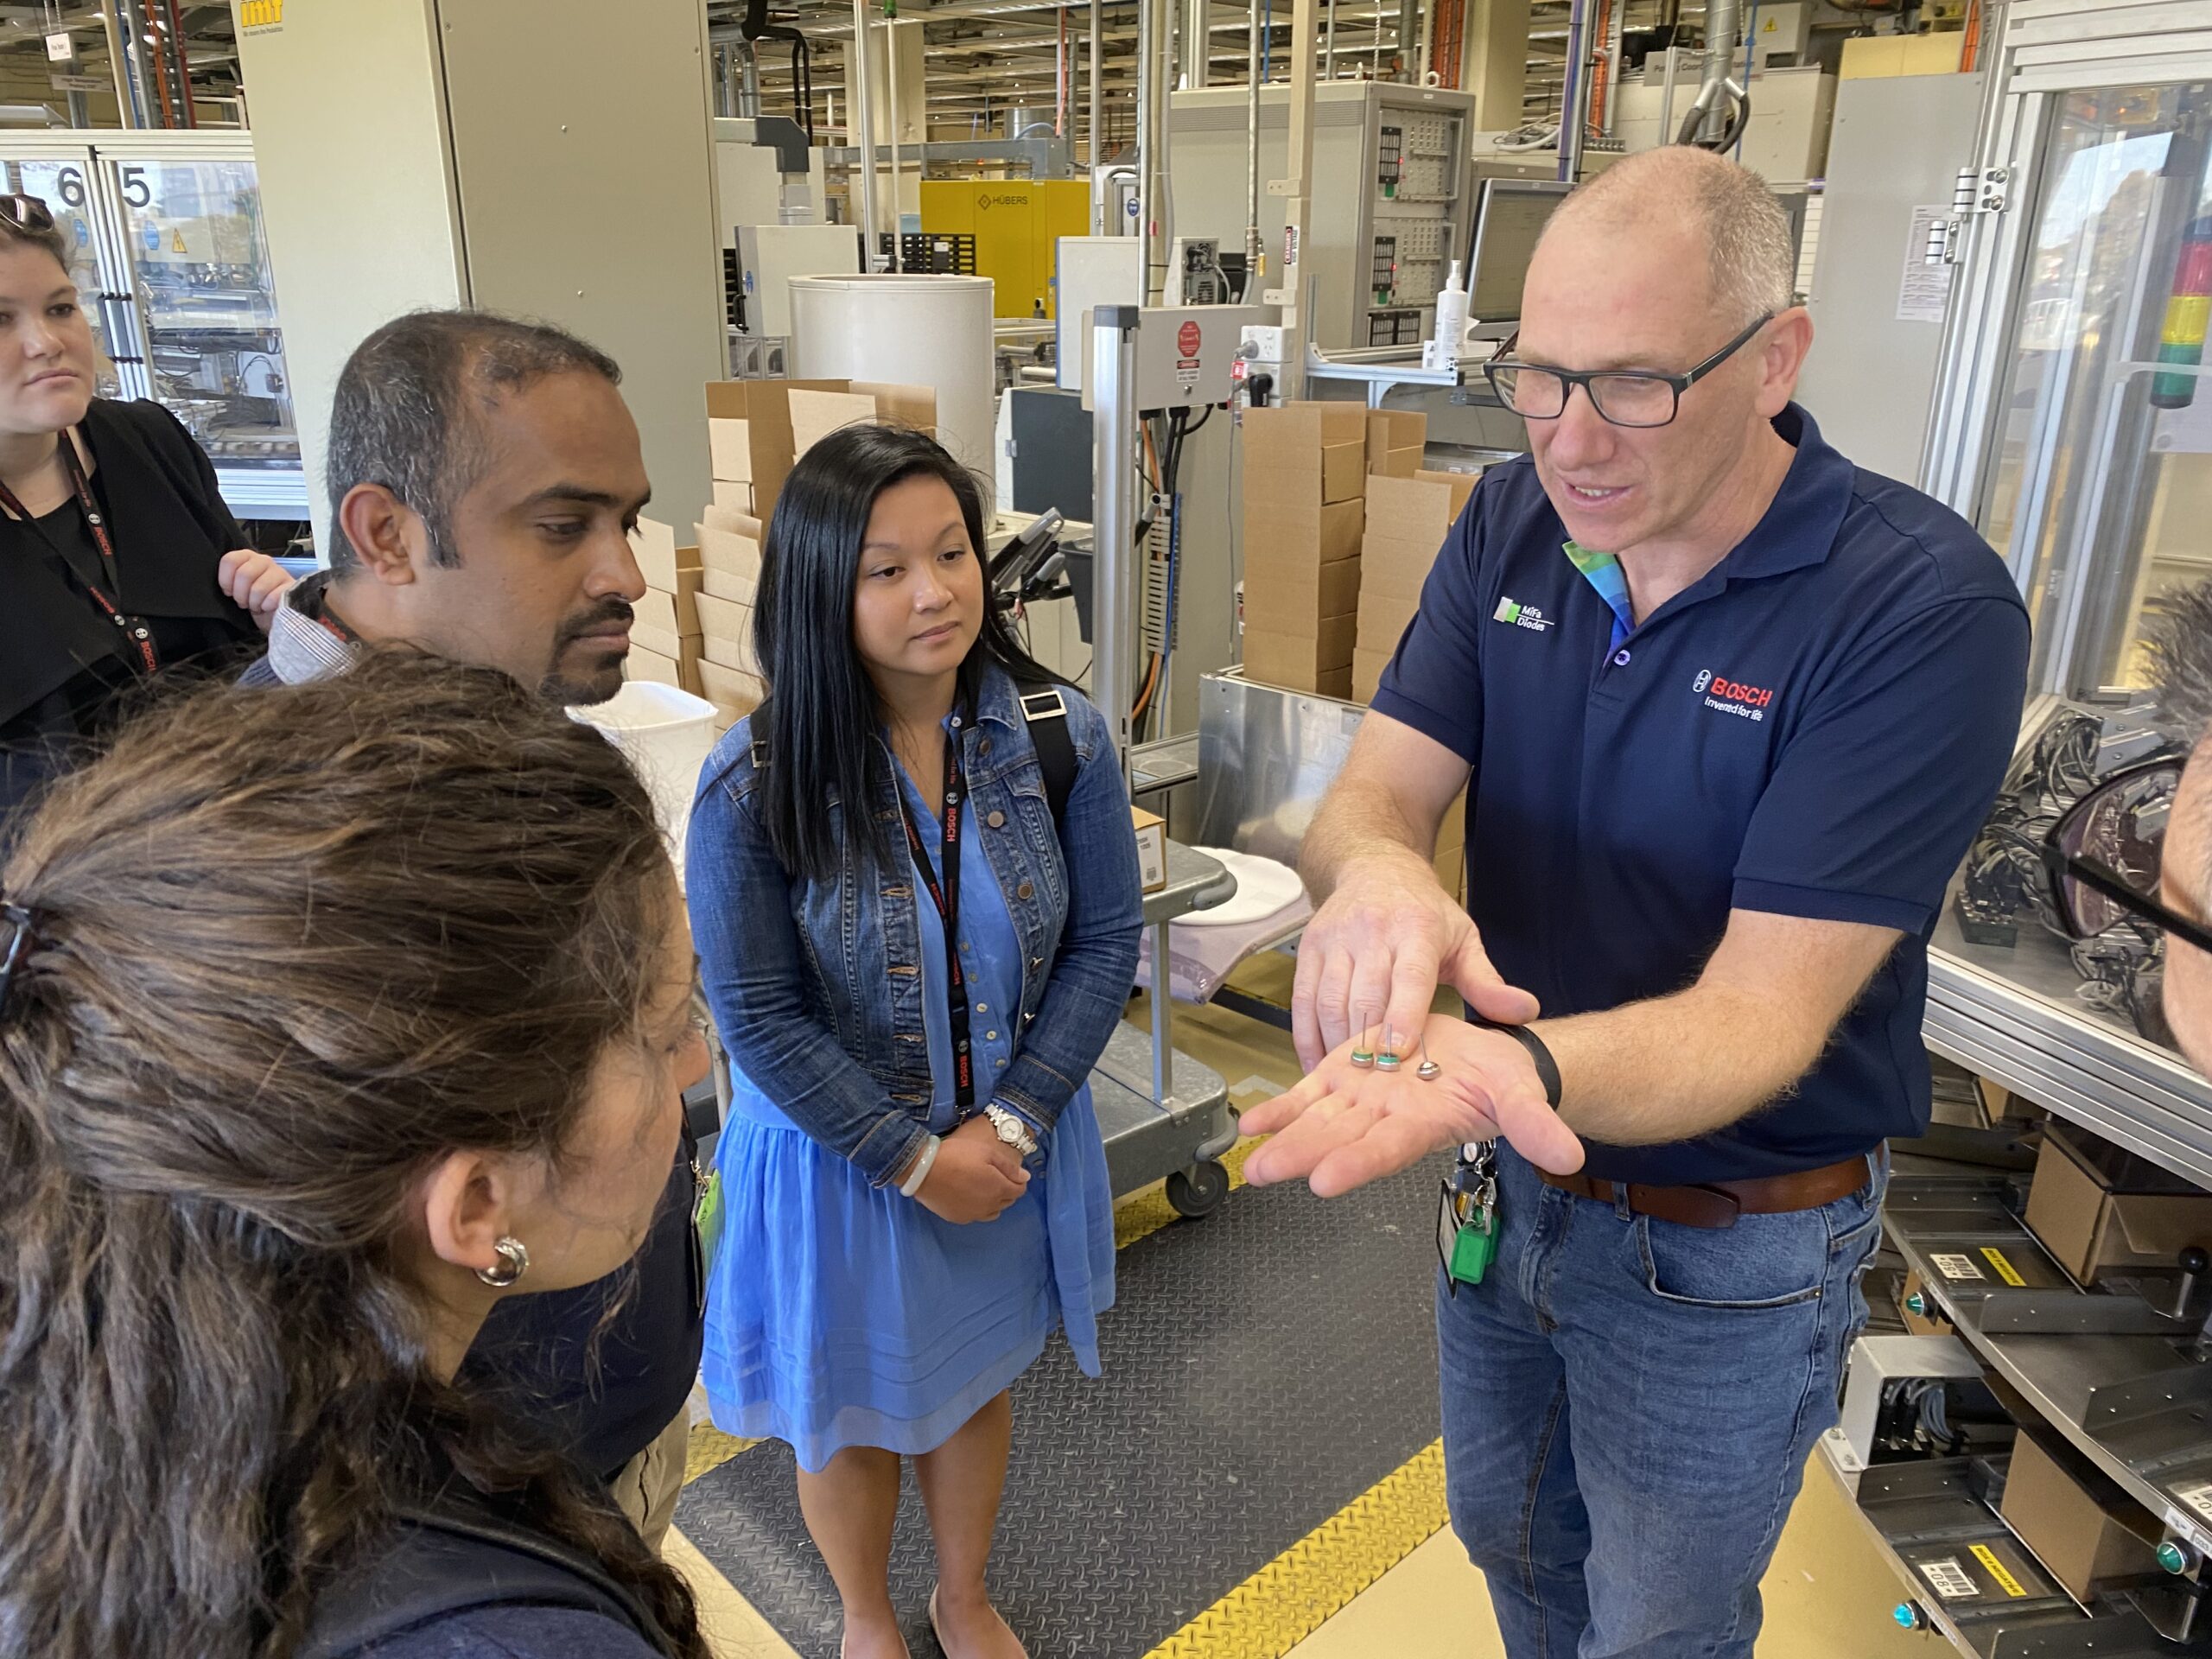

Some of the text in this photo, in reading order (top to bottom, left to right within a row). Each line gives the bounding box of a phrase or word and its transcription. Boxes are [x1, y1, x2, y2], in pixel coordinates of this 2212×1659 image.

[57, 167, 86, 207] 6
[122, 167, 150, 207] 5
[992, 194, 1028, 206] HÜBERS
[1516, 616, 1545, 632] Diodes
[1710, 677, 1773, 707] BOSCH
[946, 808, 957, 842] BOSCH
[959, 1054, 969, 1088] BOSCH
